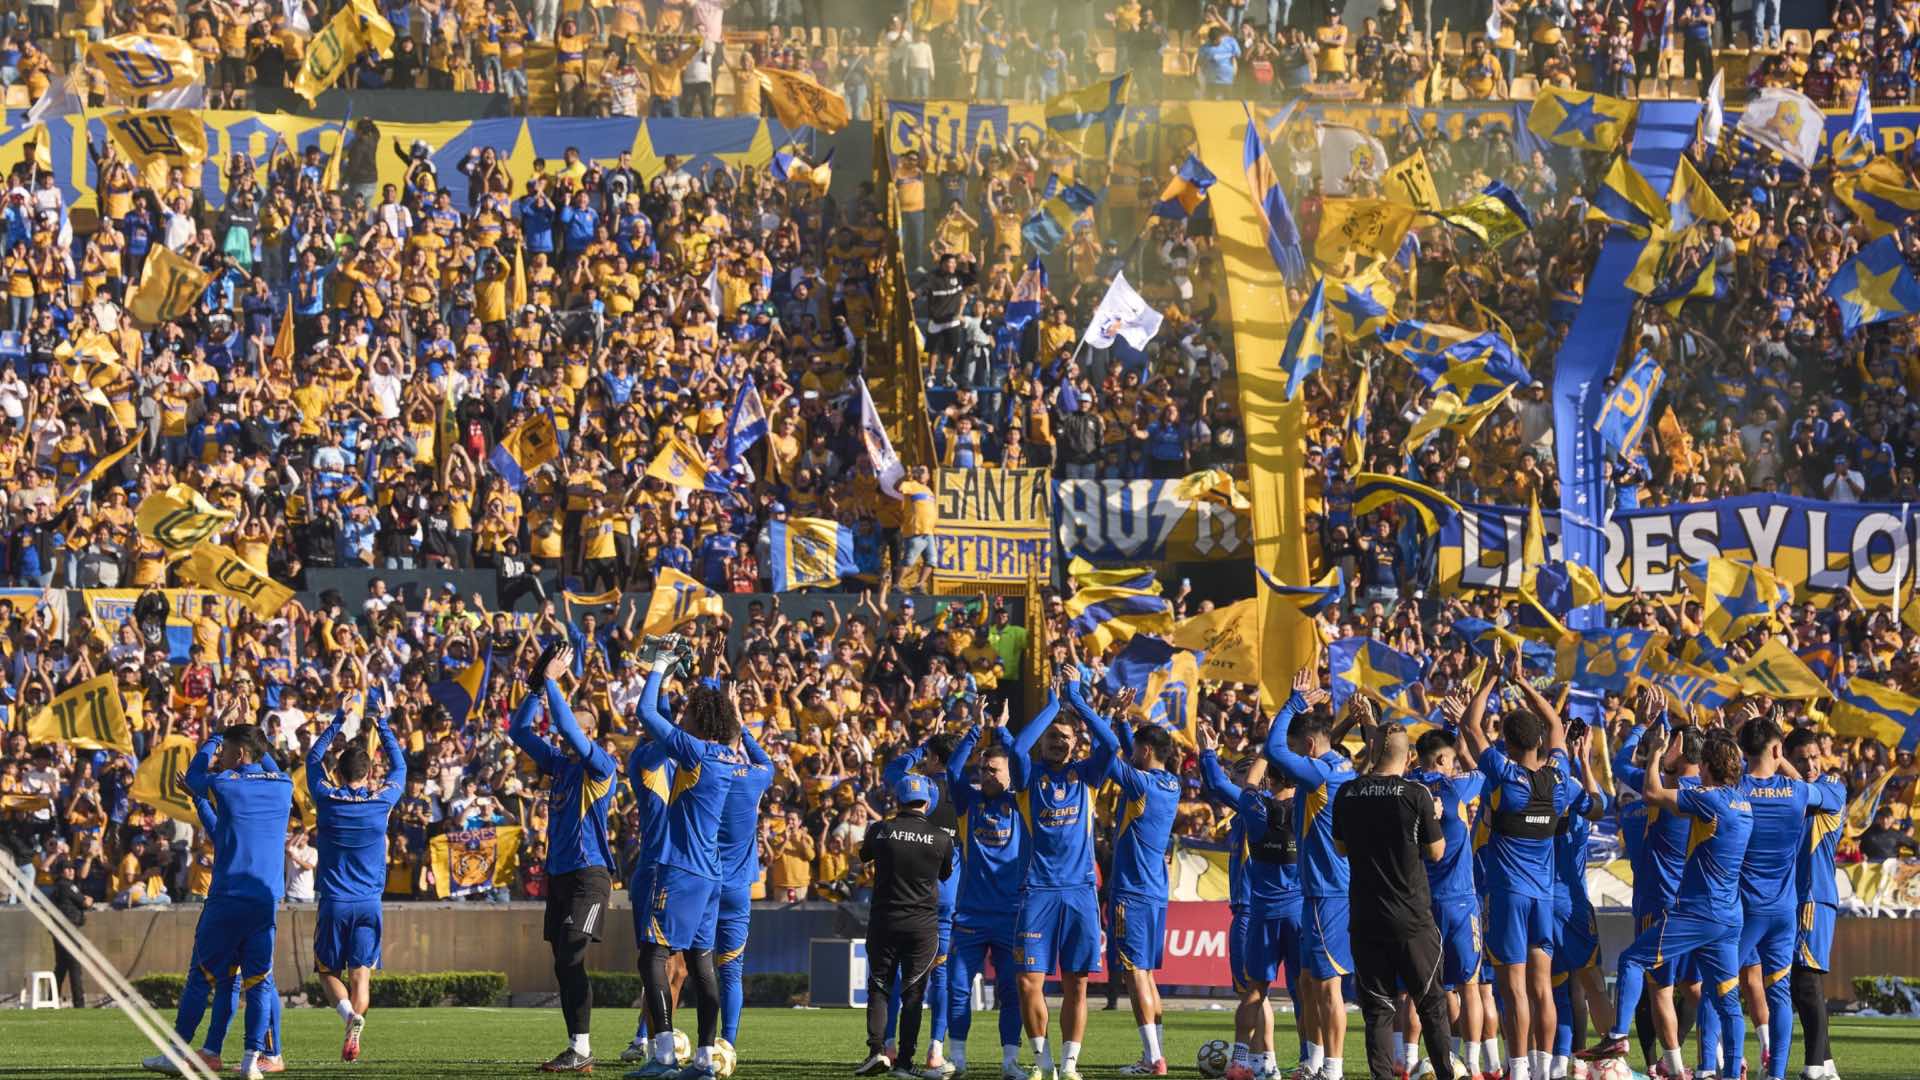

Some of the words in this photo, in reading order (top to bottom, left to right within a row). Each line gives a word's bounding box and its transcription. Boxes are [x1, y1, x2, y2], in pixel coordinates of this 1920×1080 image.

[938, 466, 1051, 521] SANTA
[1460, 511, 1720, 596] LIRES
[1807, 510, 1920, 593] LO
[1359, 785, 1404, 797] AFIRME
[1749, 786, 1793, 799] AFIRME
[447, 826, 497, 843] TIGRES
[889, 831, 935, 846] AFIRME
